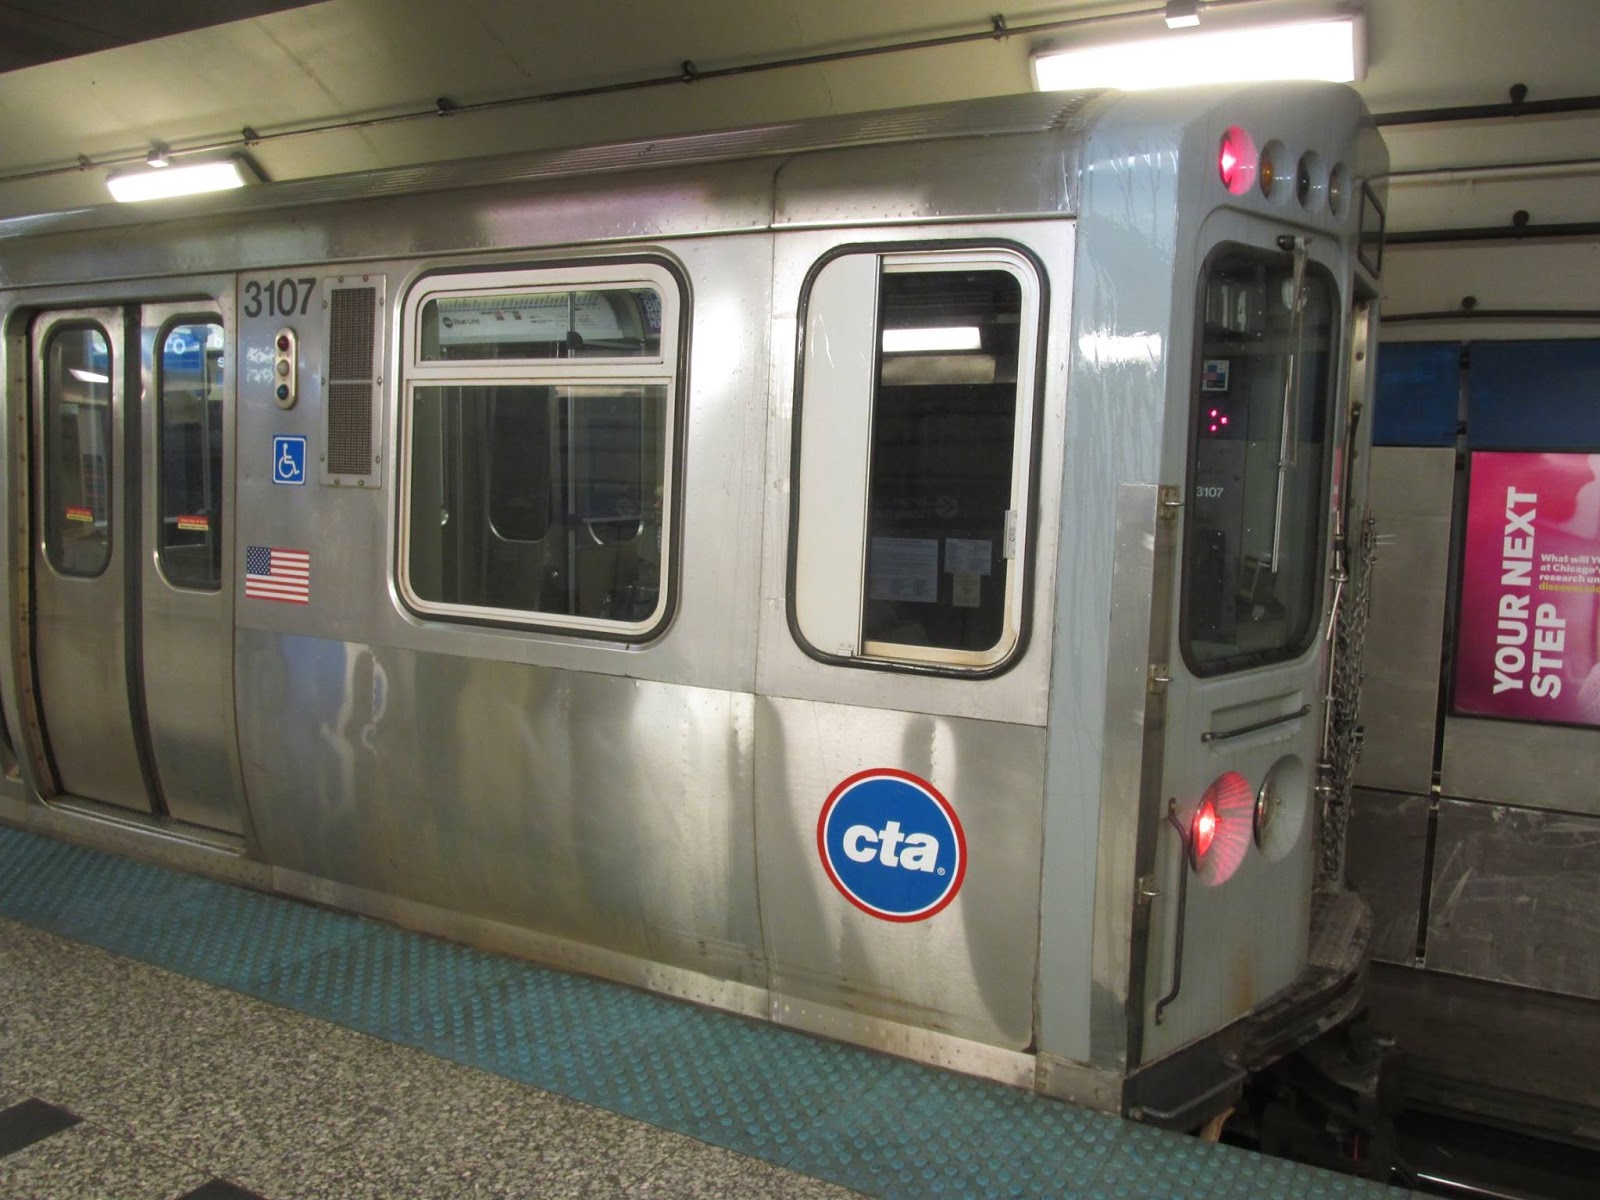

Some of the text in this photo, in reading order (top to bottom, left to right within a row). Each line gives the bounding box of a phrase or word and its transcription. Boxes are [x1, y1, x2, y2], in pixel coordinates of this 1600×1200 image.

[244, 278, 317, 318] 3107
[1196, 486, 1224, 498] 3107
[1539, 574, 1585, 582] research
[1541, 554, 1569, 563] What
[1571, 556, 1589, 564] will
[1493, 486, 1537, 694] YOUR NEXT
[1530, 603, 1567, 699] STEP
[843, 820, 939, 873] cta
